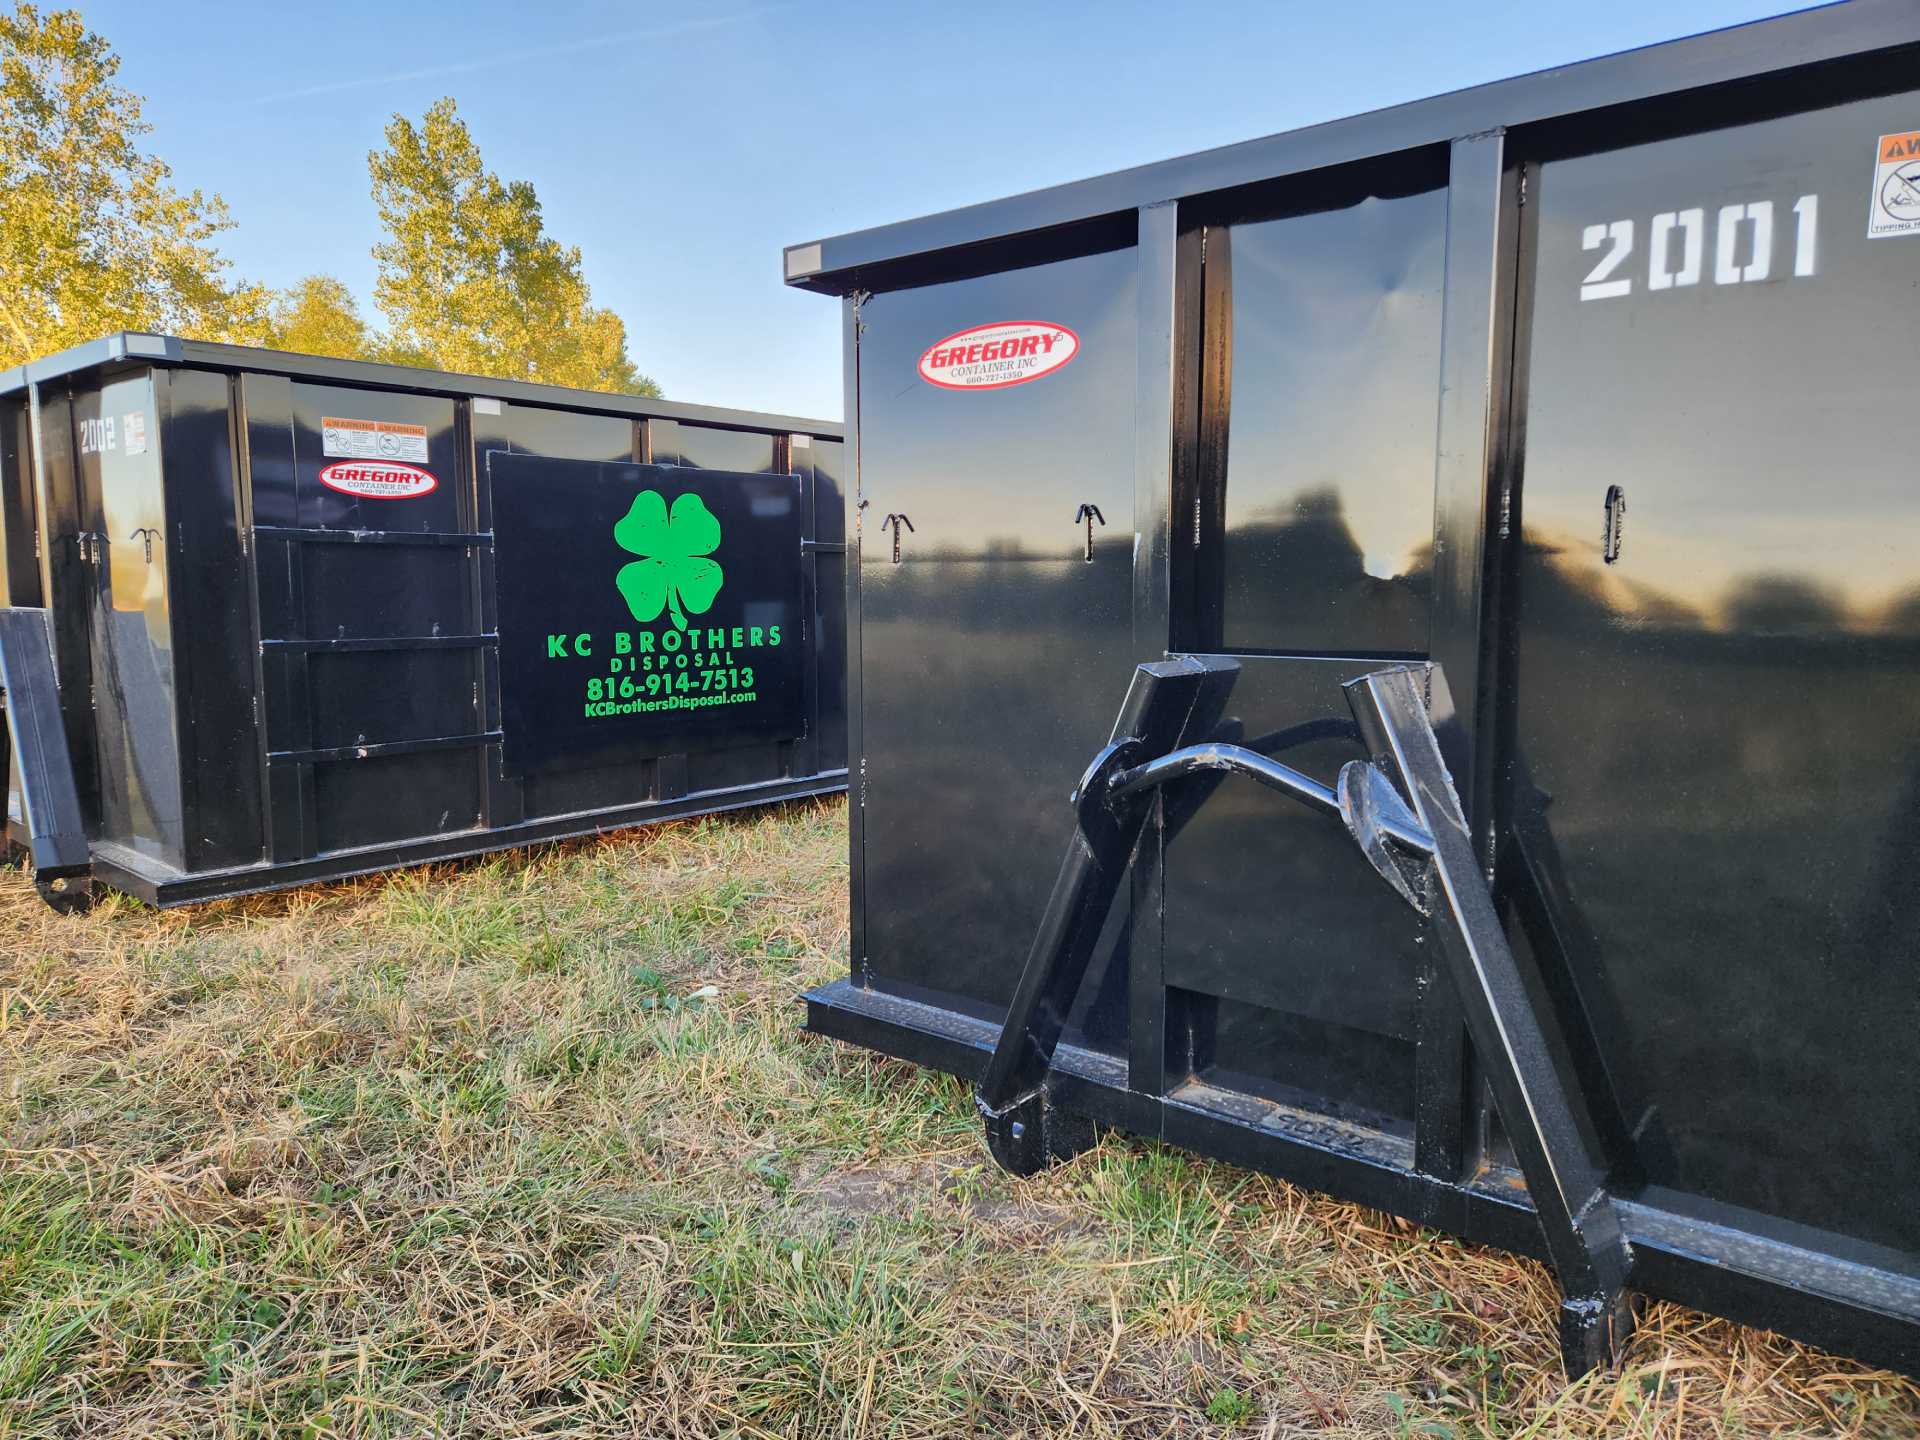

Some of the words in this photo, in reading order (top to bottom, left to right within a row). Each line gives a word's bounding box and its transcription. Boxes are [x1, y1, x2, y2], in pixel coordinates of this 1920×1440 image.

[1580, 194, 1818, 301] 2001
[930, 333, 1059, 368] GREGORY
[951, 361, 1014, 377] CONTAINER
[1017, 357, 1038, 369] INC
[330, 468, 424, 484] GREGORY
[347, 481, 395, 490] CONTAINER
[548, 634, 592, 657] KC
[615, 626, 781, 654] BROTHERS
[610, 652, 733, 673] DISPOSAL
[587, 668, 754, 700] 816-914-7513
[585, 691, 757, 717] KCBrothersDisposal.com
